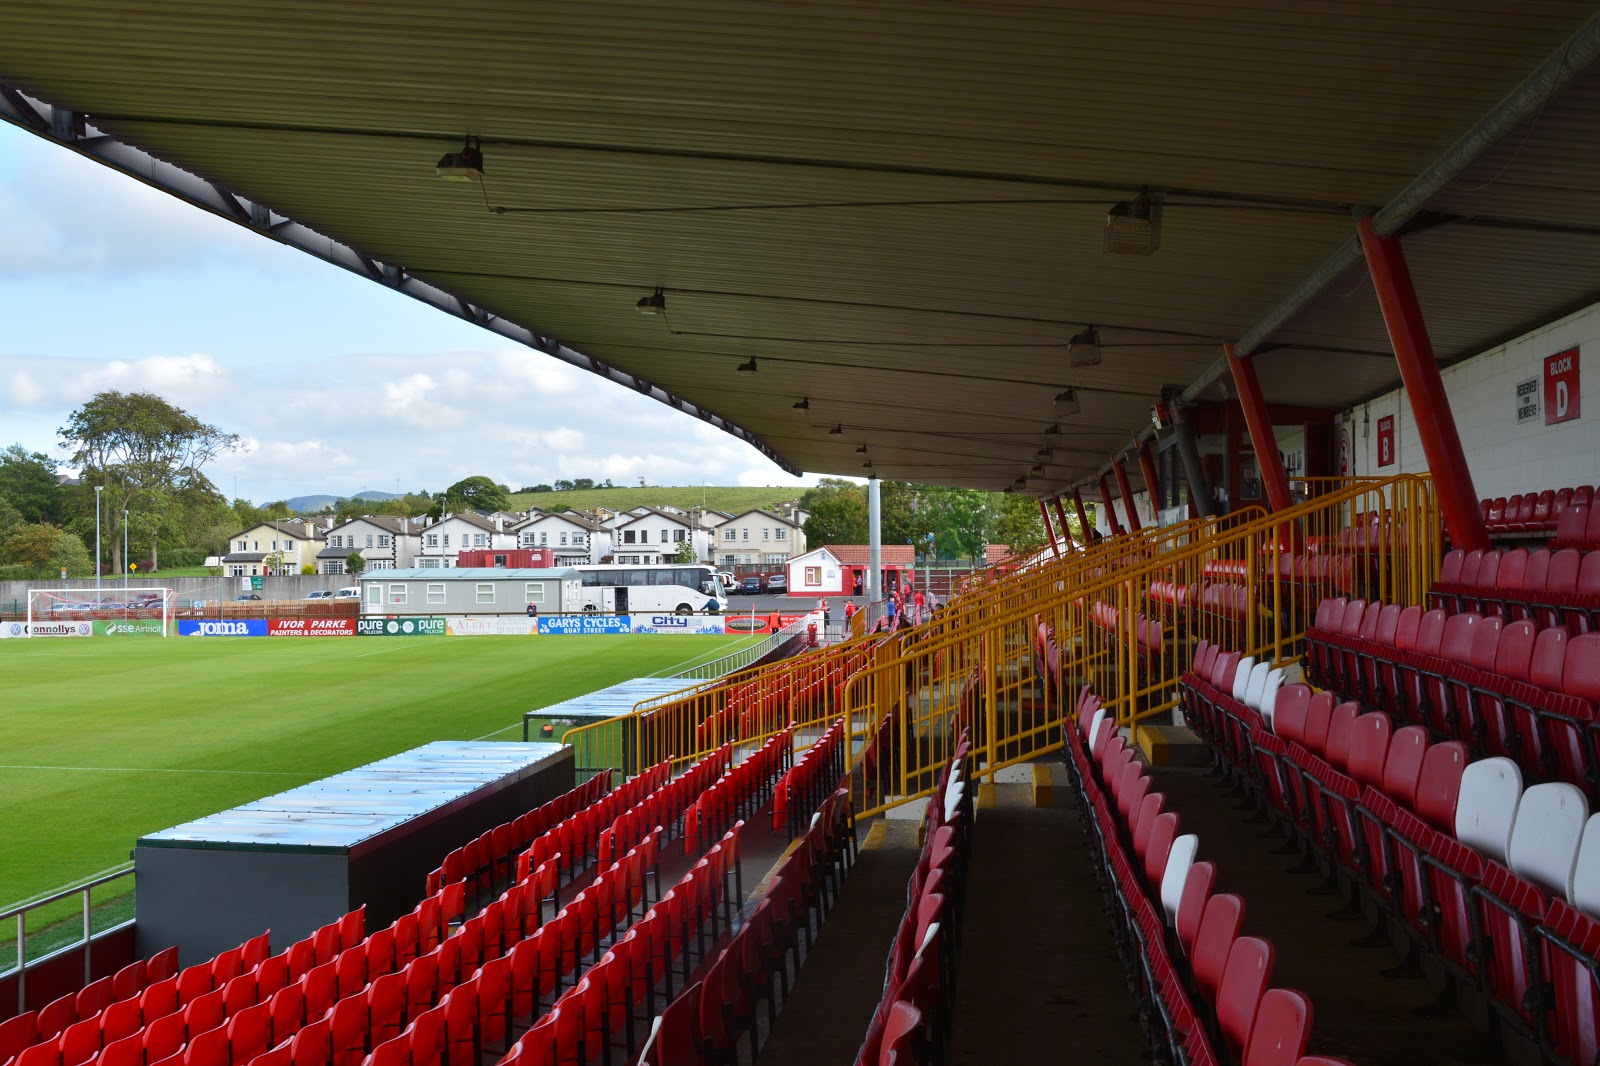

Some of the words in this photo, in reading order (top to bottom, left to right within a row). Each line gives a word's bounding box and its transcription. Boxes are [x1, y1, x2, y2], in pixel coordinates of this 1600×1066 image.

[1551, 356, 1572, 376] BLOCK
[1516, 379, 1537, 397] RESERVED
[1556, 380, 1568, 418] D
[1517, 404, 1537, 420] MEMBERS
[1380, 420, 1391, 432] BLOCK
[1383, 436, 1389, 462] B
[278, 620, 305, 629] IVOR
[311, 620, 347, 629] PARKE
[357, 620, 383, 632] pure
[418, 619, 444, 632] pure
[547, 618, 581, 628] GARYS
[583, 617, 621, 628] CYCLES
[652, 616, 687, 626] City
